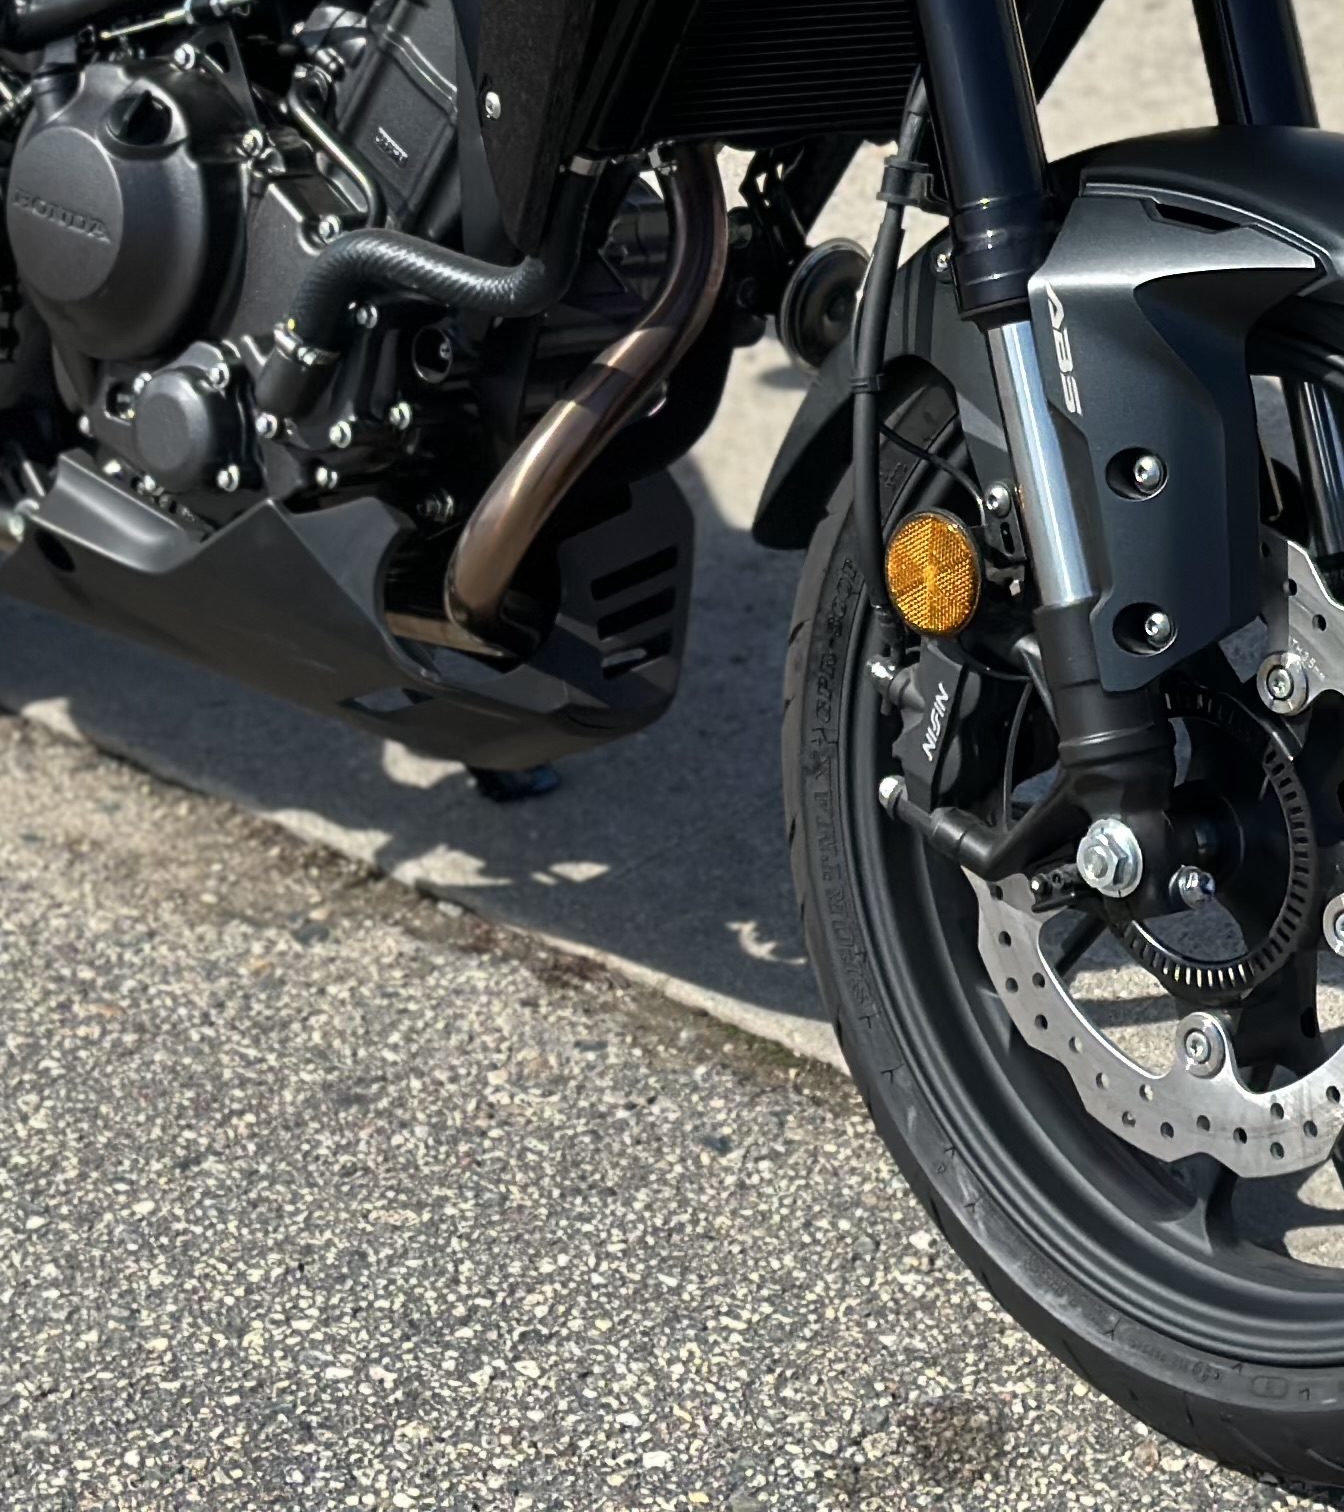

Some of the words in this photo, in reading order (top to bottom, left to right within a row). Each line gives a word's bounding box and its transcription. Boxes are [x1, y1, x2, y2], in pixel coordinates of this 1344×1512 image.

[12, 188, 113, 245] HONDA
[1045, 281, 1084, 417] ABS
[921, 681, 950, 762] NISSIN
